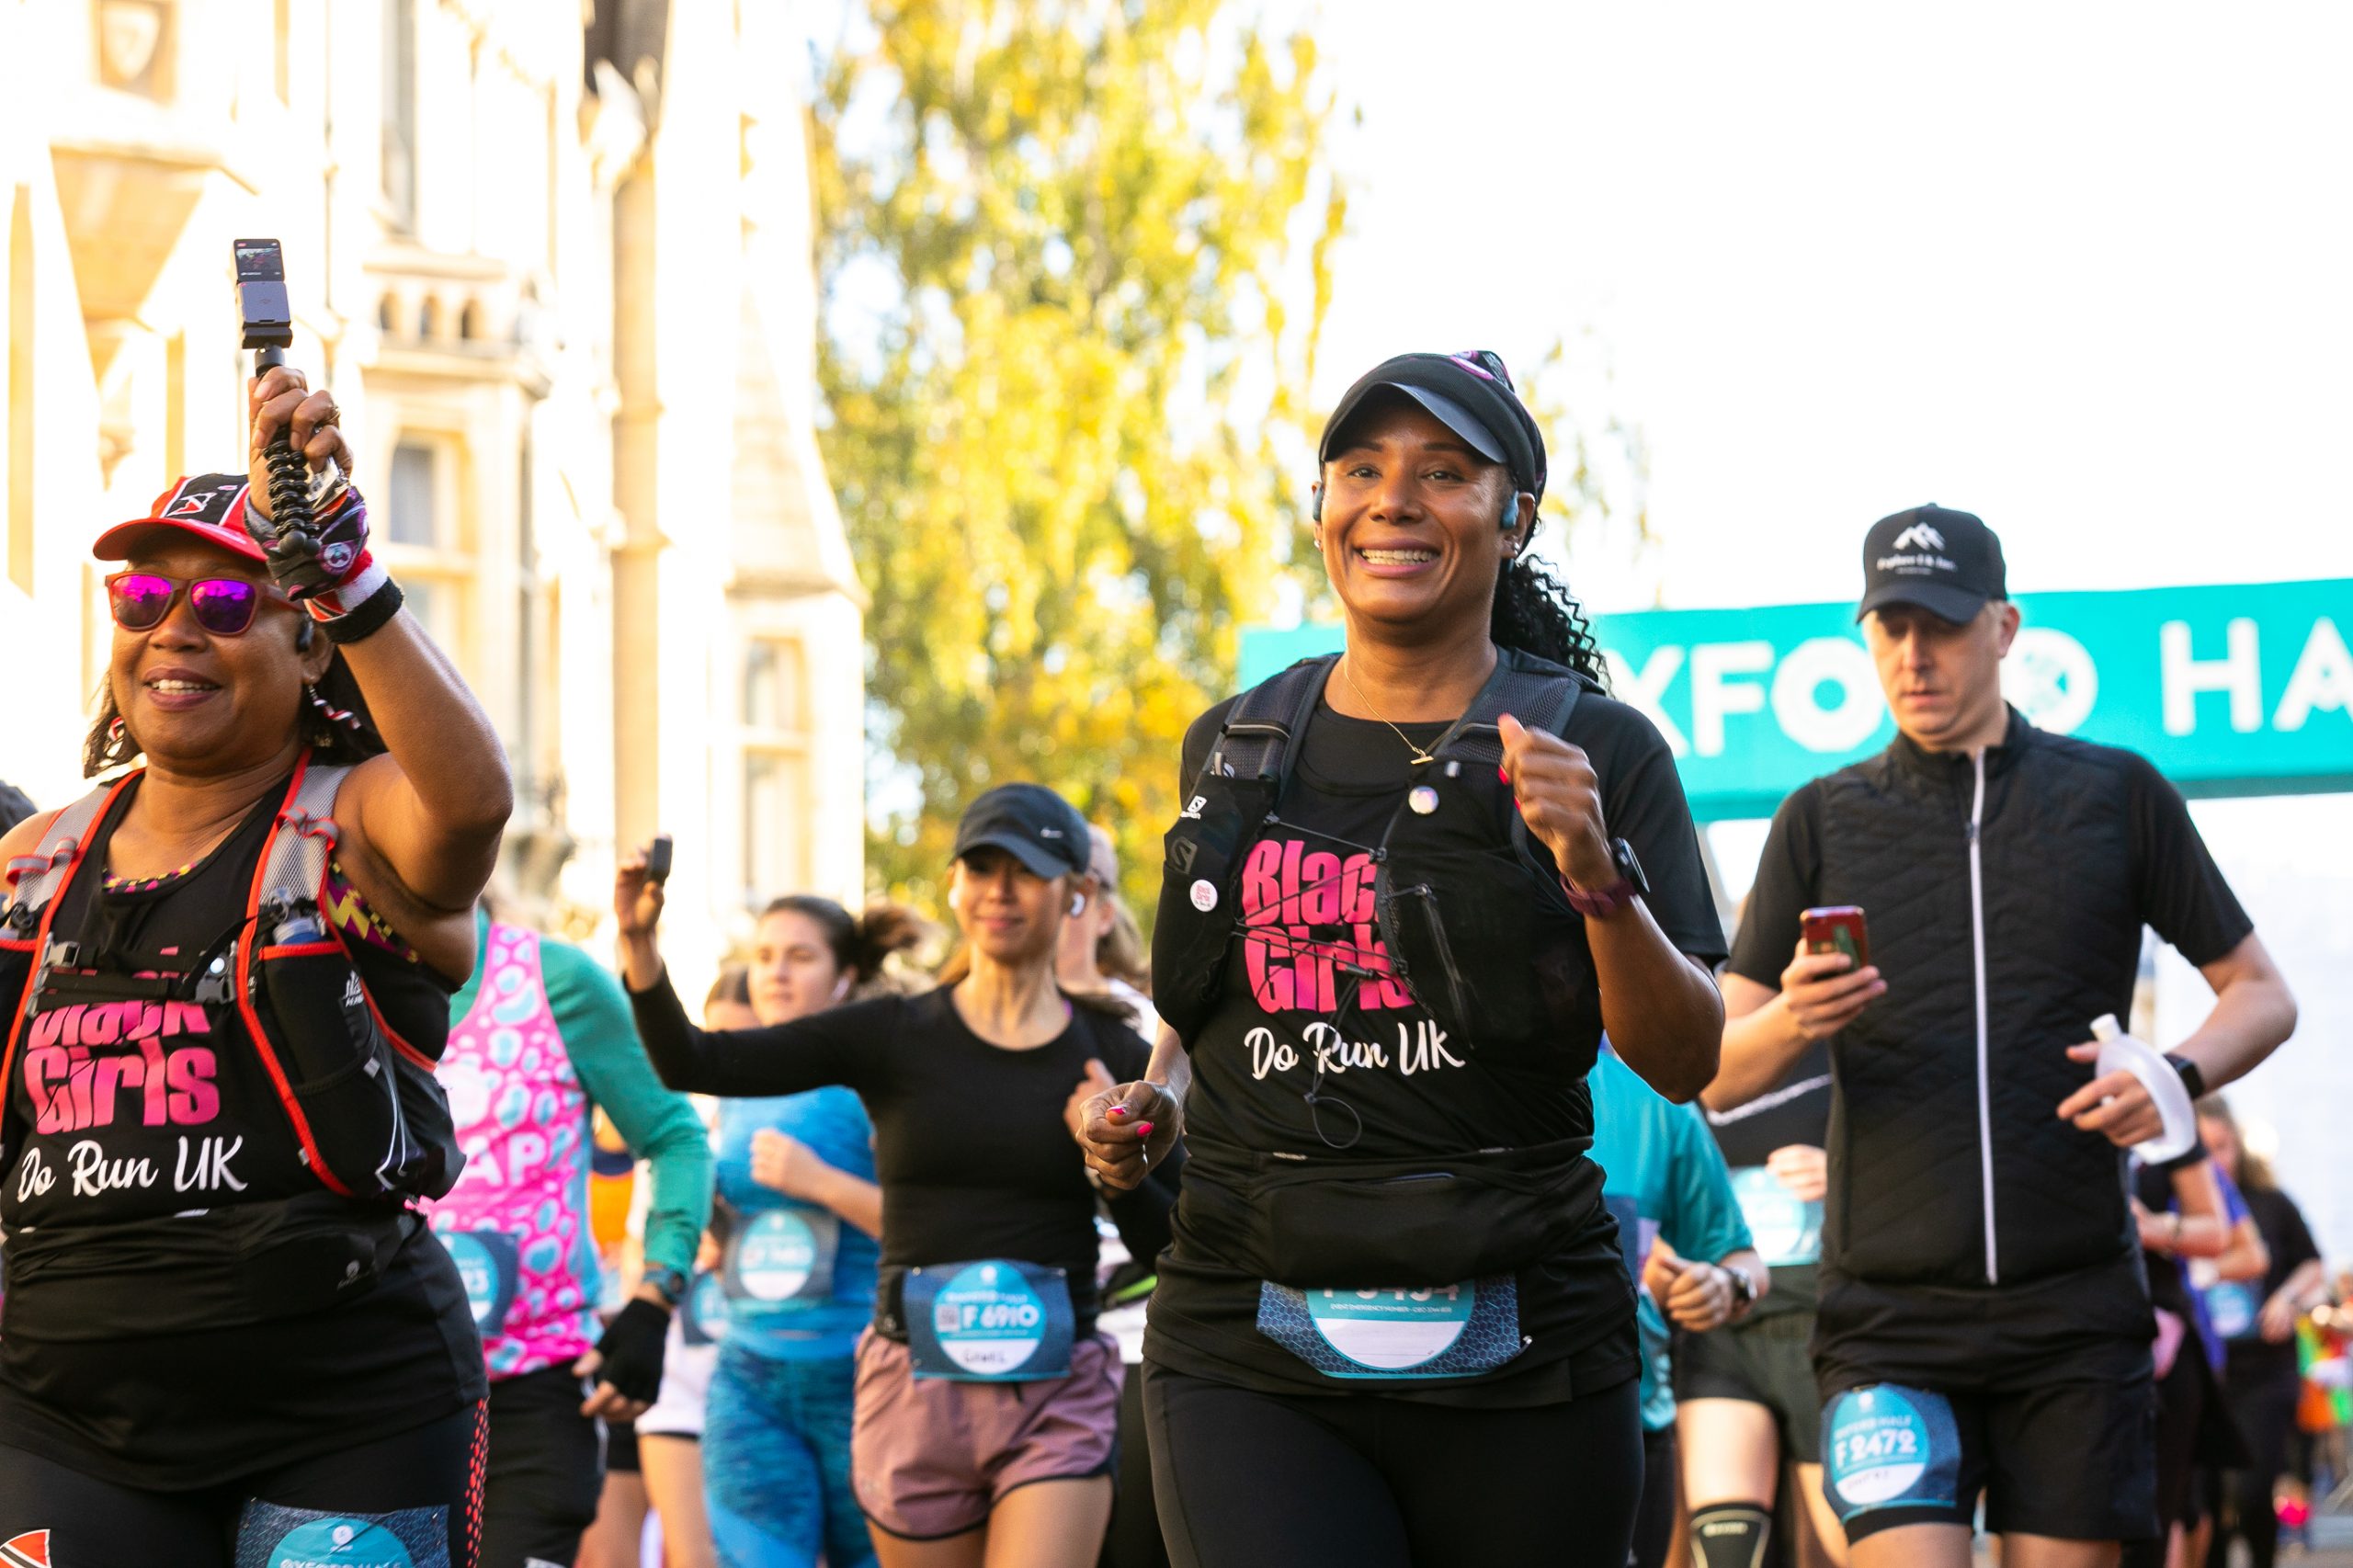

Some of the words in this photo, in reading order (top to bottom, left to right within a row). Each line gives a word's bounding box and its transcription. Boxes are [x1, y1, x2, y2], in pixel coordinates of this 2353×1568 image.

[1601, 627, 2098, 759] XFOD
[1242, 839, 1379, 926] Blac
[1244, 1027, 1299, 1080] Do
[1302, 1021, 1389, 1074] Run
[1397, 1018, 1466, 1076] UK
[23, 1035, 221, 1135] Girls
[17, 1147, 56, 1203] Do
[67, 1140, 159, 1197] Run
[174, 1135, 248, 1192] UK
[457, 1131, 548, 1187] AP
[980, 1303, 1040, 1328] 6910
[1848, 1428, 1917, 1462] 2472
